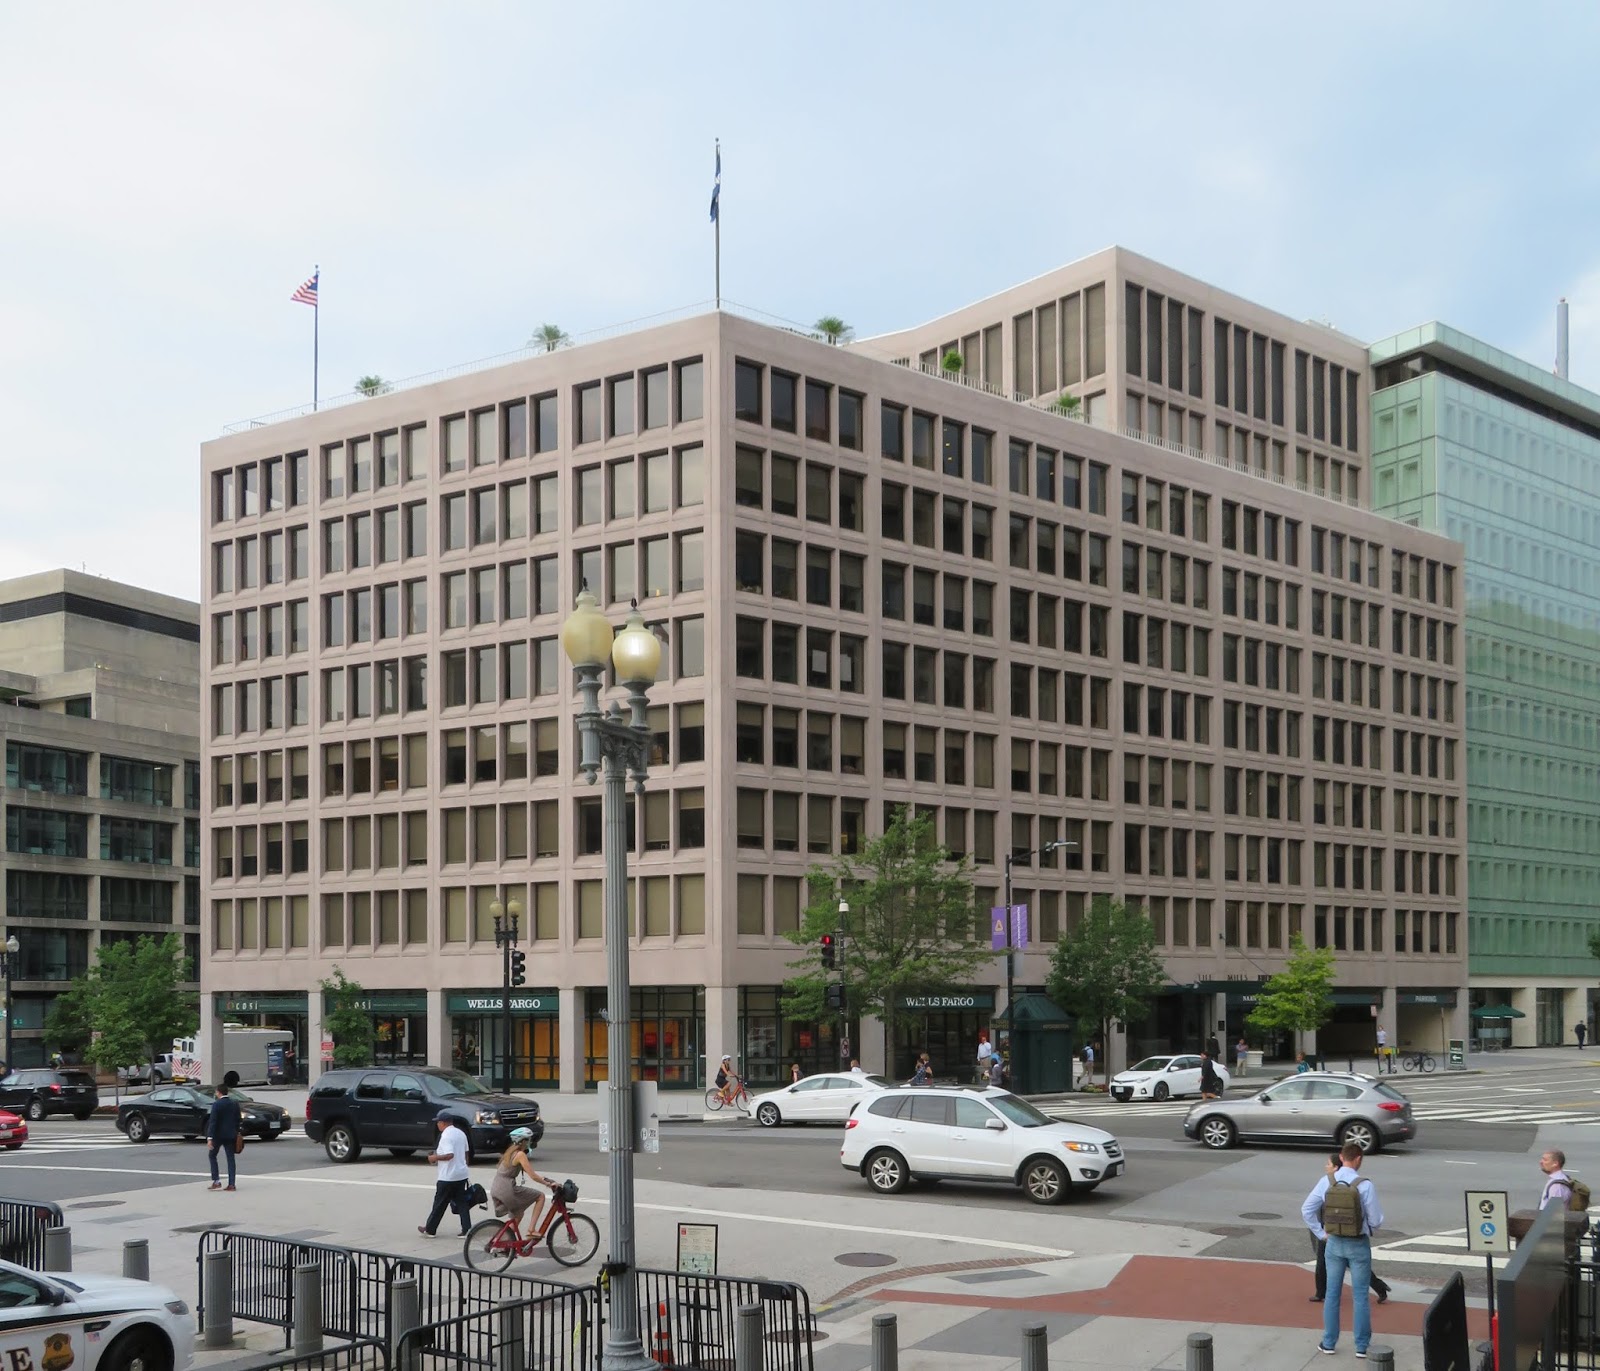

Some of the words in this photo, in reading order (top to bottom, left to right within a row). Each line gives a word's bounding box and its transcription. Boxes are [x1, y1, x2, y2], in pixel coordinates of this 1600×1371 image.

[467, 999, 503, 1009] WELLS
[508, 999, 541, 1009] ARGO
[942, 997, 974, 1007] FARGO
[0, 1346, 34, 1371] E
